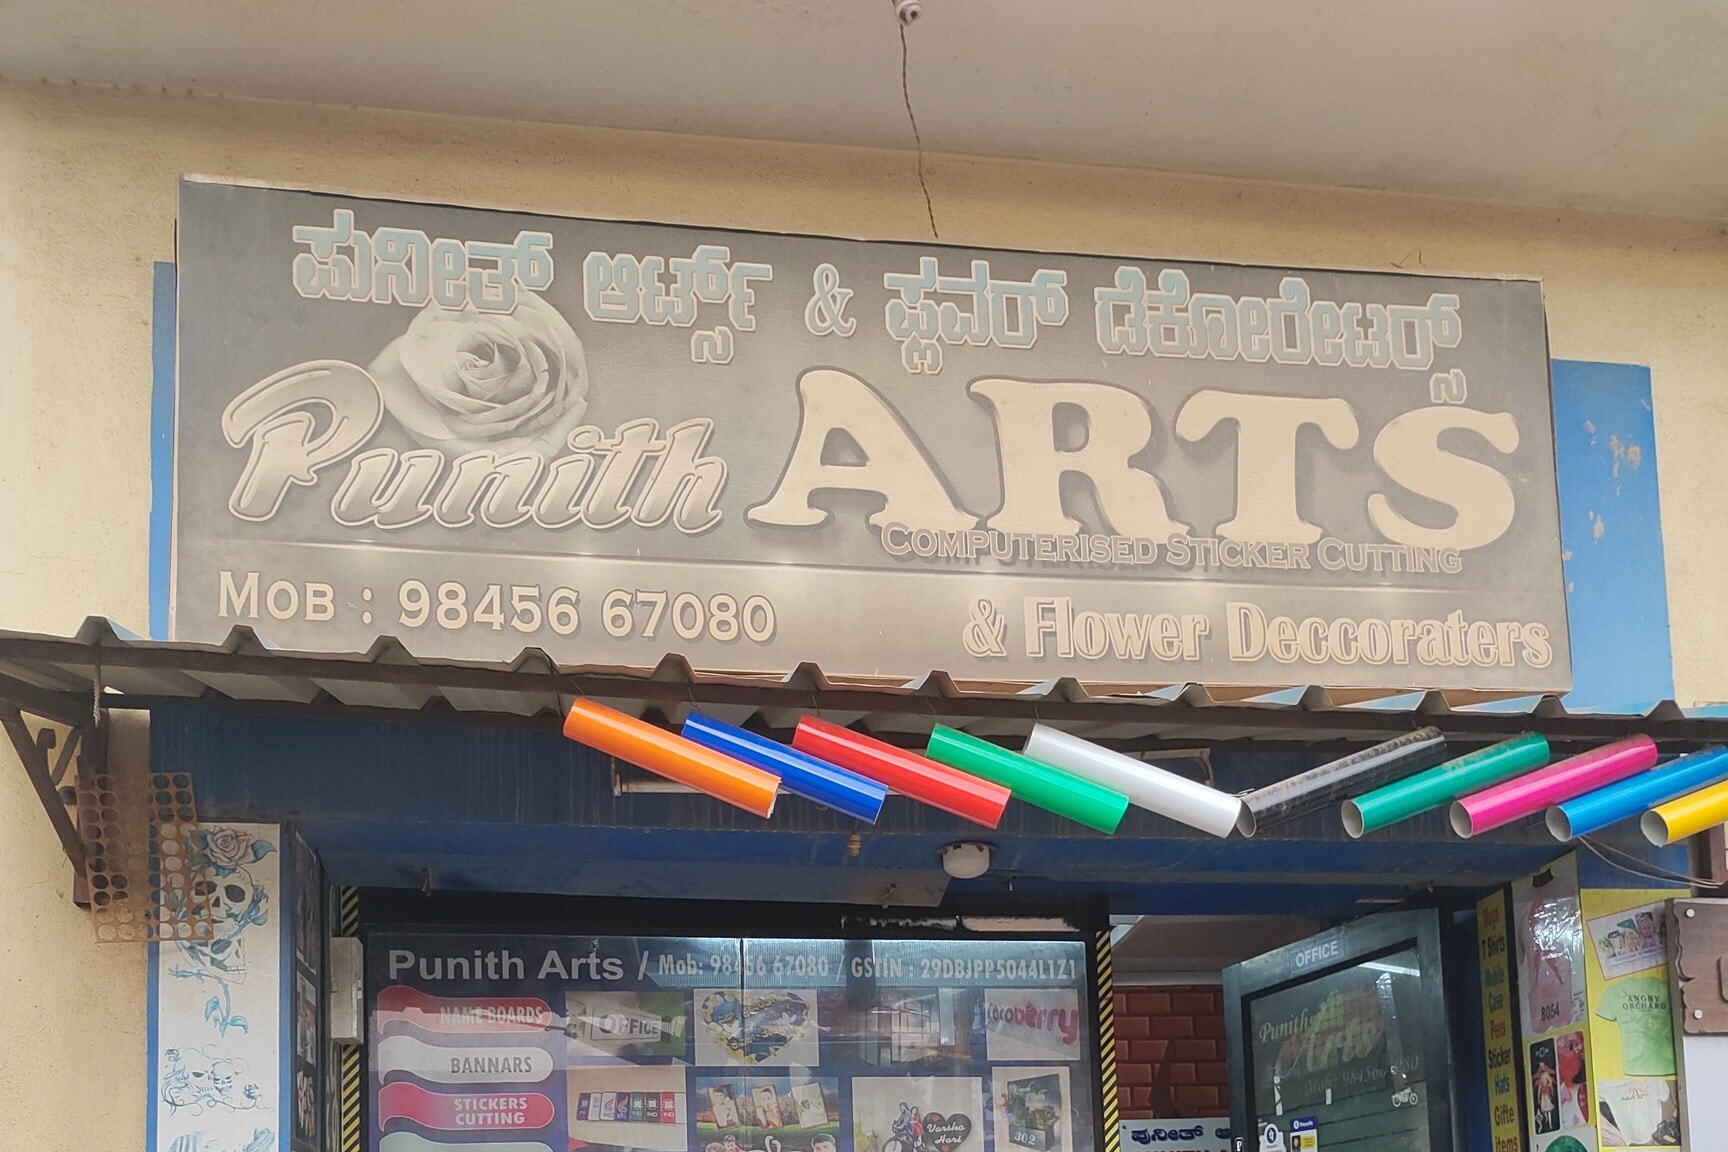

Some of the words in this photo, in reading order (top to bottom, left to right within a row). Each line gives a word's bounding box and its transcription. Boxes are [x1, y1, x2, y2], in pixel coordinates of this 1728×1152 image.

[804, 262, 857, 338] &
[222, 360, 729, 534] Punith
[746, 367, 1521, 550] ARTS
[398, 579, 580, 637] 98456
[600, 589, 776, 643] 67080
[962, 596, 1006, 660] &
[1024, 596, 1210, 663] Flower
[1226, 602, 1553, 669] Deccoraters
[388, 948, 524, 981] Punith
[537, 949, 624, 981] Arts
[773, 955, 829, 978] 67080
[1294, 940, 1339, 968] OFFICE
[487, 1005, 544, 1026] BOARDS
[450, 1056, 534, 1075] BANNARS
[454, 1096, 528, 1113] STICKERS
[455, 1111, 526, 1127] CUTTING
[934, 1132, 962, 1145] Hari
[1014, 1131, 1037, 1146] 302
